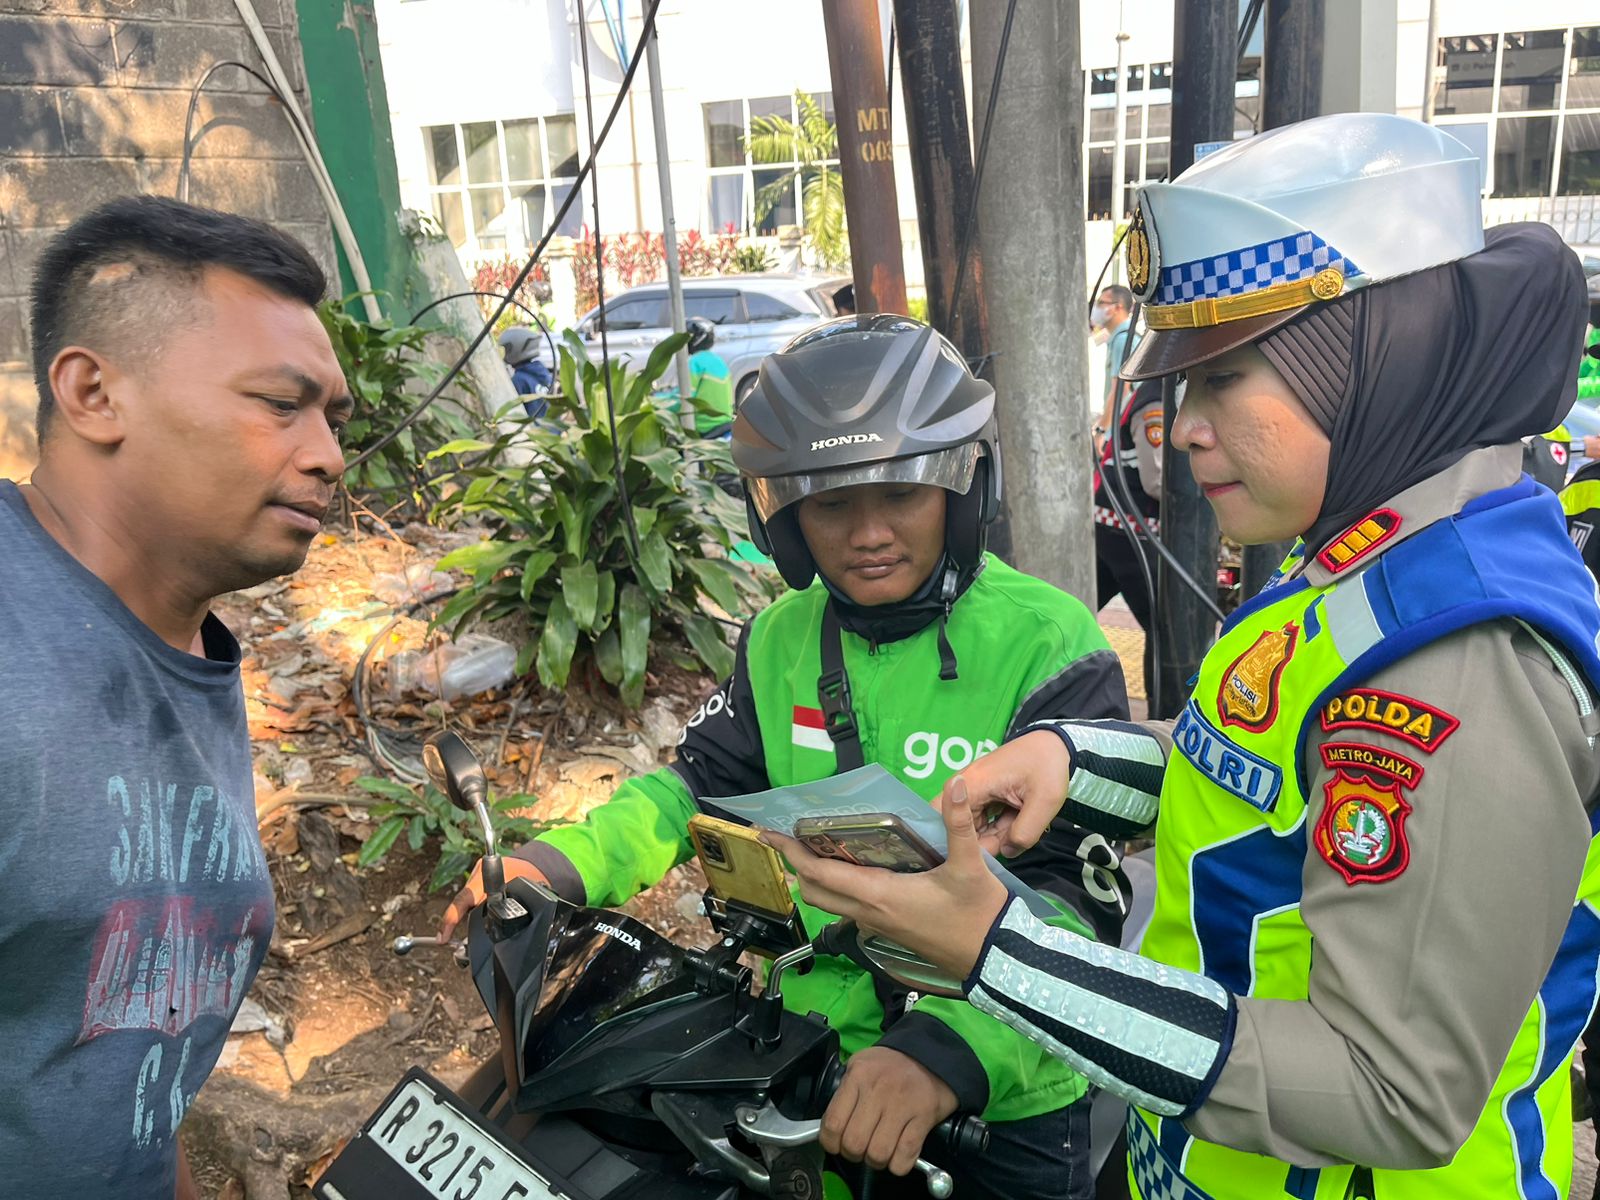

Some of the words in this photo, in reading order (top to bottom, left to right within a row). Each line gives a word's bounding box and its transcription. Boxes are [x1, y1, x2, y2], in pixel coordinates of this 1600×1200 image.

[857, 108, 888, 132] MT
[810, 432, 883, 451] HONDA
[1232, 674, 1257, 704] POLISI
[1325, 693, 1434, 743] POLDA
[1175, 709, 1262, 798] POLRI
[594, 921, 642, 951] HONDA
[380, 1095, 421, 1144] R
[404, 1119, 495, 1200] 3215
